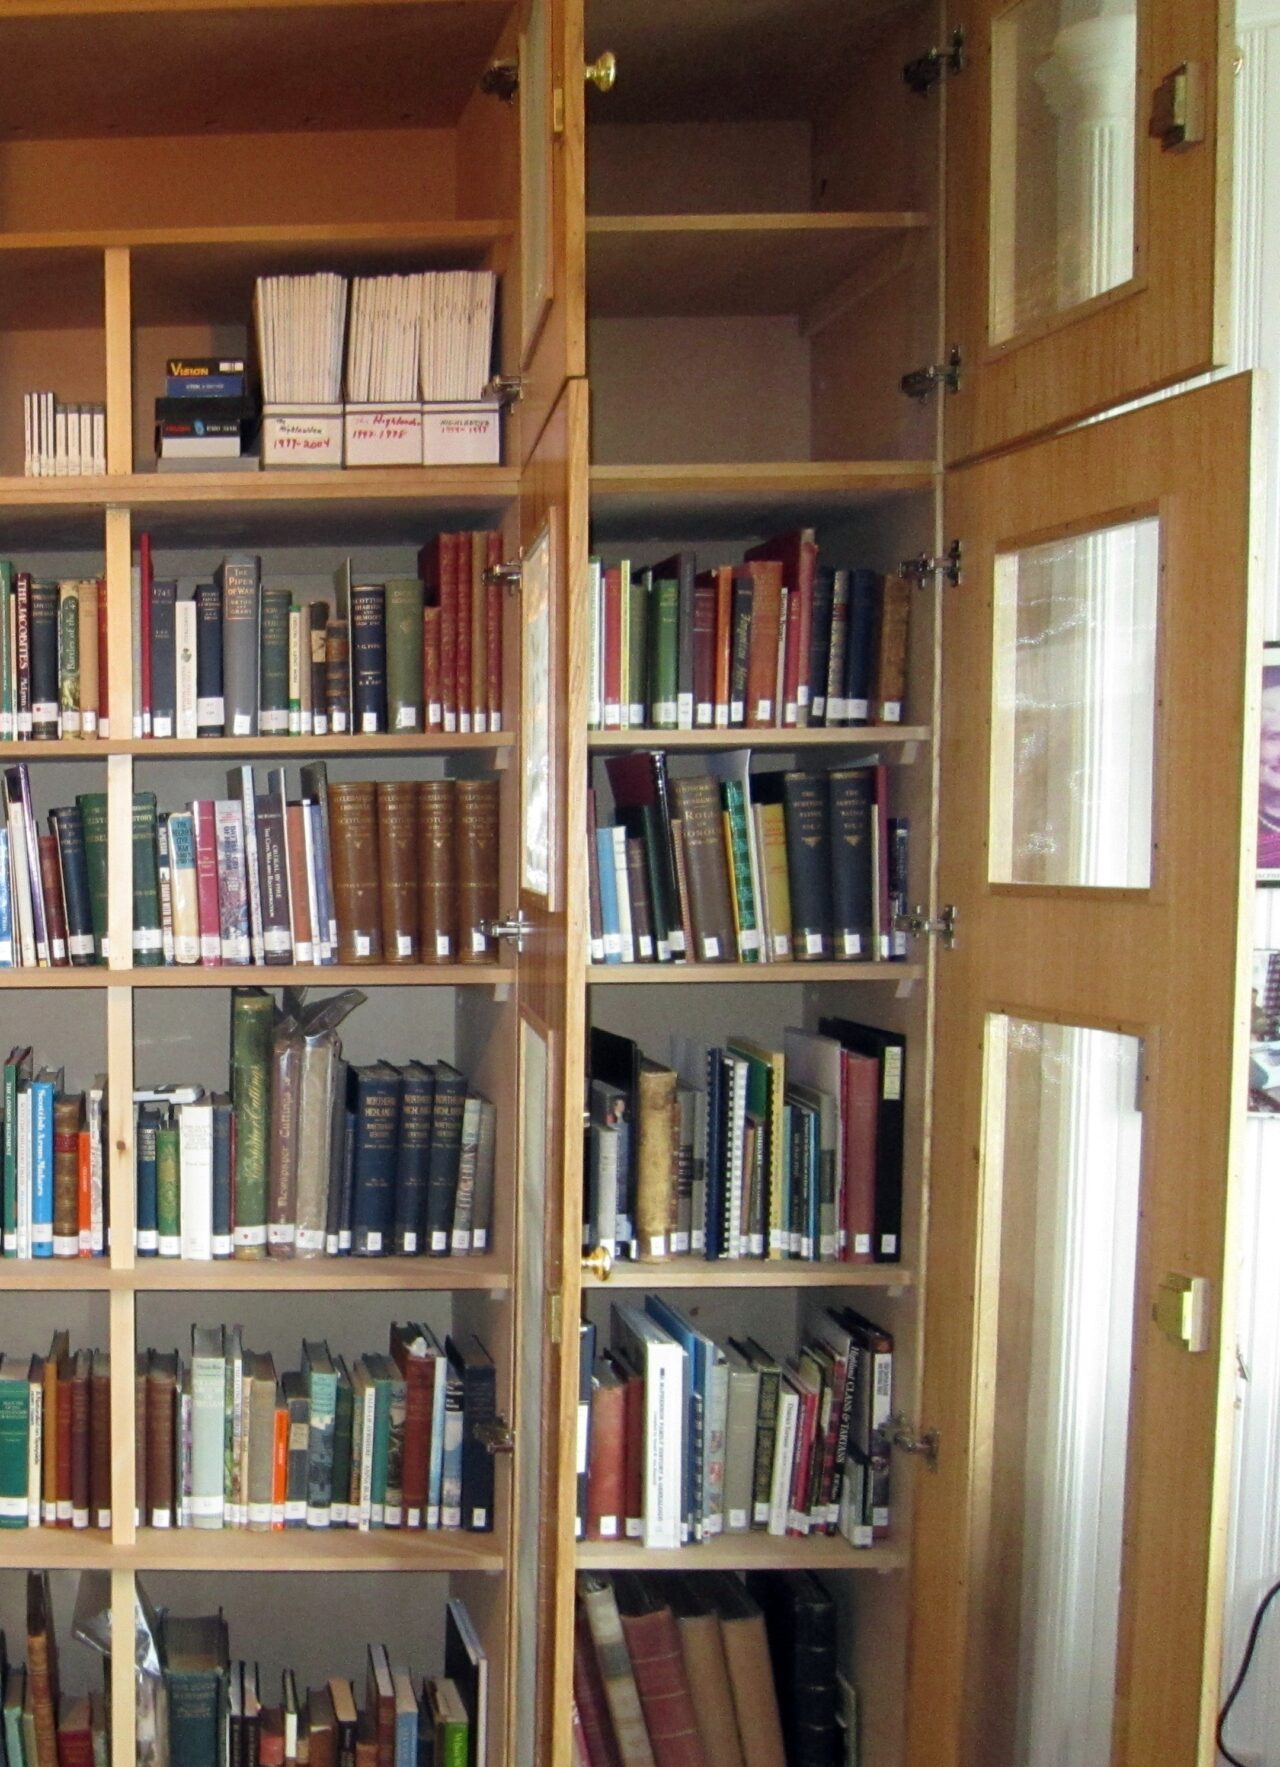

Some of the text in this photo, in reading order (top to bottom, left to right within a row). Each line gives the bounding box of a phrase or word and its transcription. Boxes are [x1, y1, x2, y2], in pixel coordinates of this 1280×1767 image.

[18, 579, 27, 604] THE
[18, 604, 28, 670] JACOBITES
[37, 1089, 46, 1130] Scottish
[279, 1092, 292, 1138] Cuttings
[843, 1382, 855, 1412] CLANS
[837, 1424, 849, 1463] TARTANS
